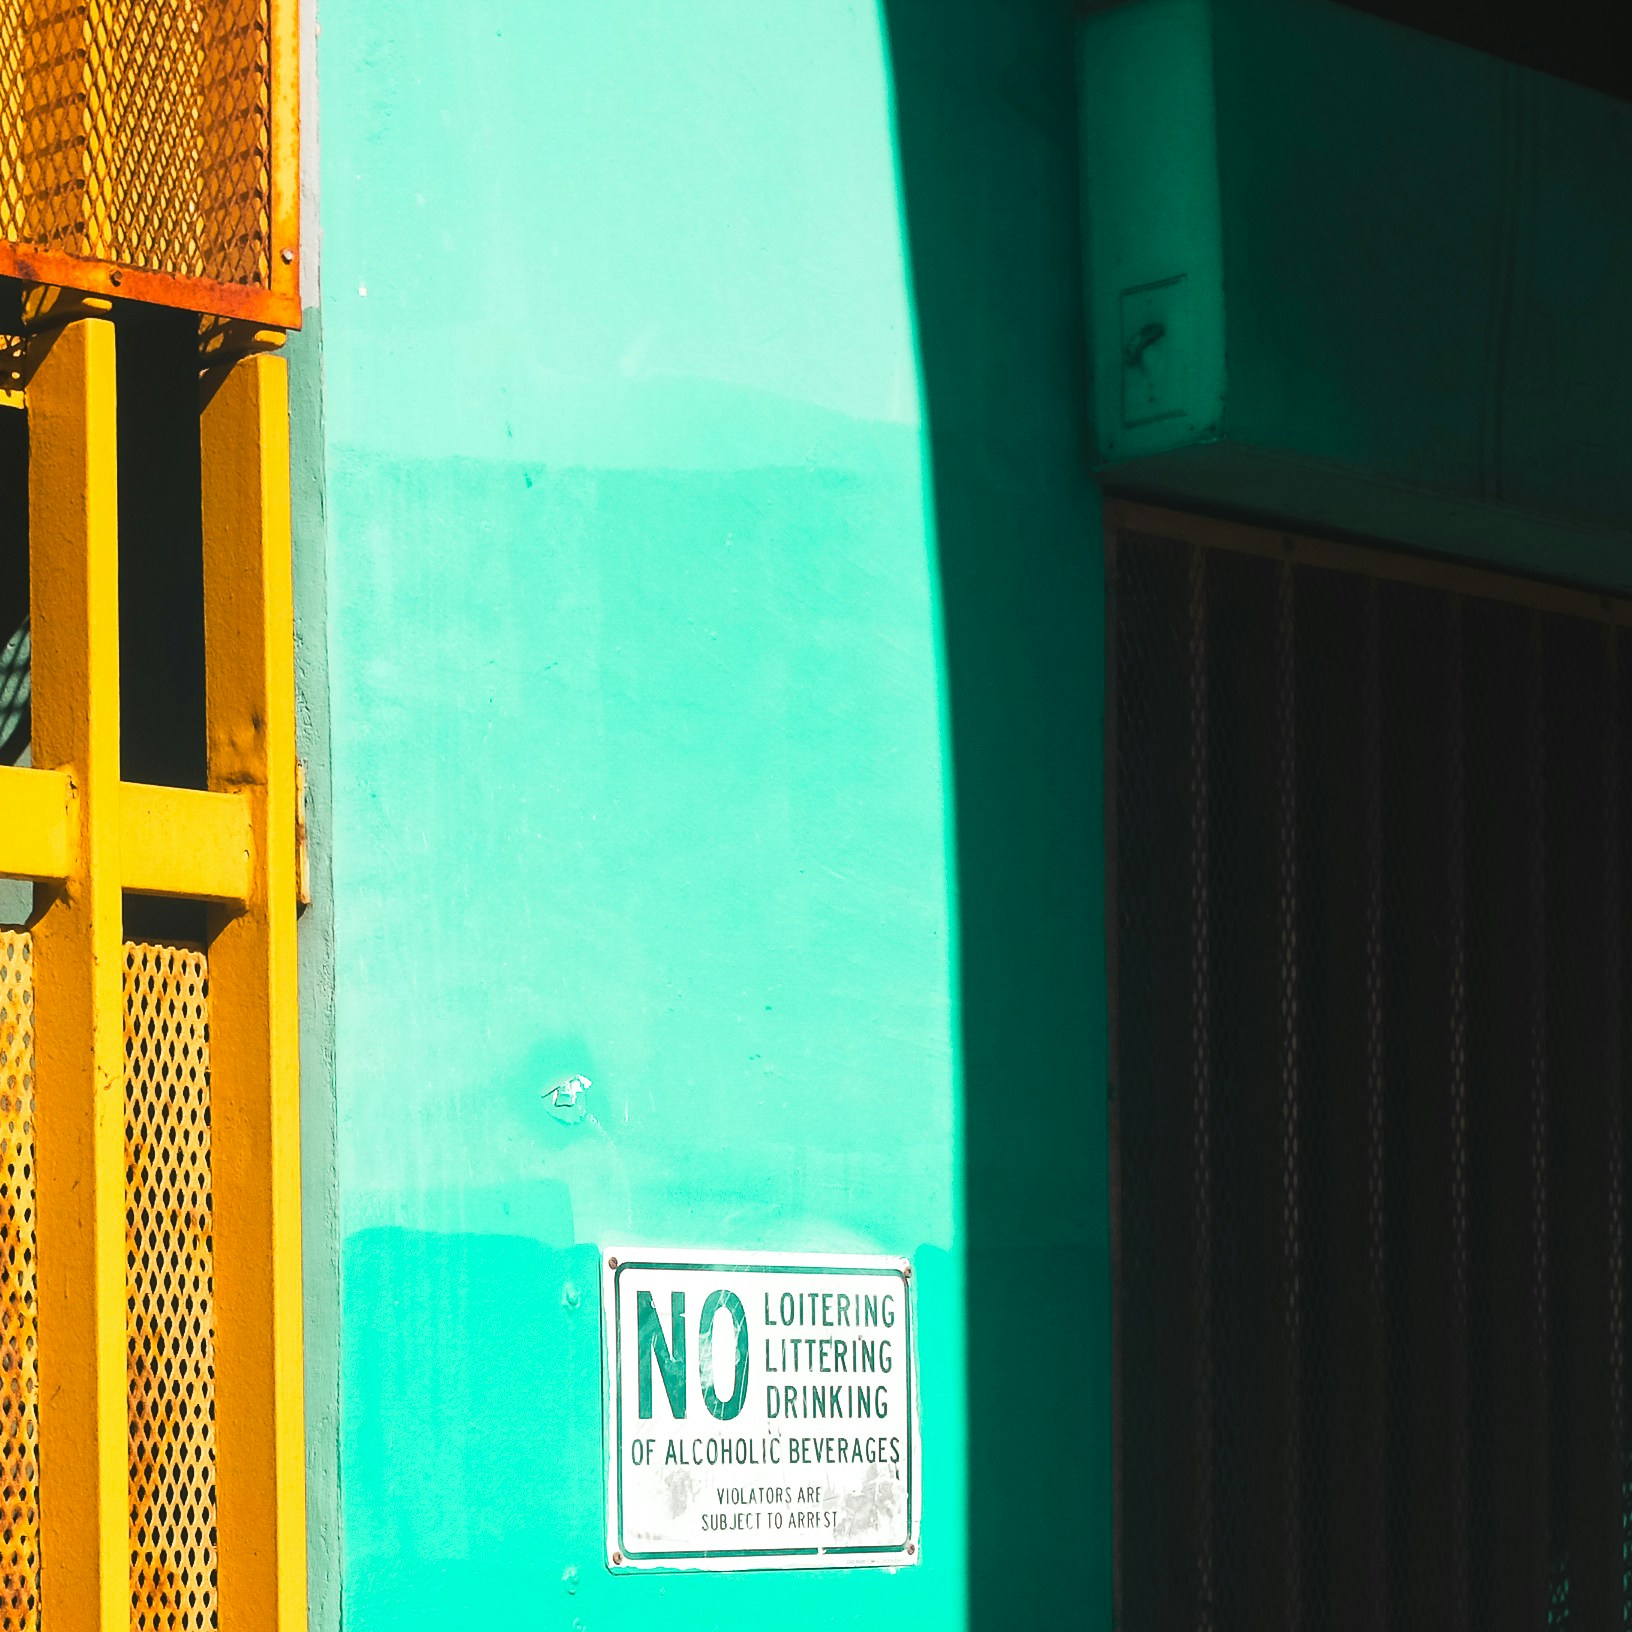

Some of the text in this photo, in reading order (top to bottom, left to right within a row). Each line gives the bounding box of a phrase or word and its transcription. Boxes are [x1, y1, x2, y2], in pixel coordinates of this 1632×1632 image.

[764, 1292, 895, 1328] LOITERING
[636, 1289, 750, 1421] NO
[765, 1339, 893, 1373] LITTERING
[767, 1385, 889, 1419] DRINKING
[631, 1437, 900, 1466] OF ALCOHOLIC BEVERAGES
[717, 1486, 821, 1505] VIOLATORS ARE
[701, 1511, 838, 1532] SUBJECT TO ARREST
